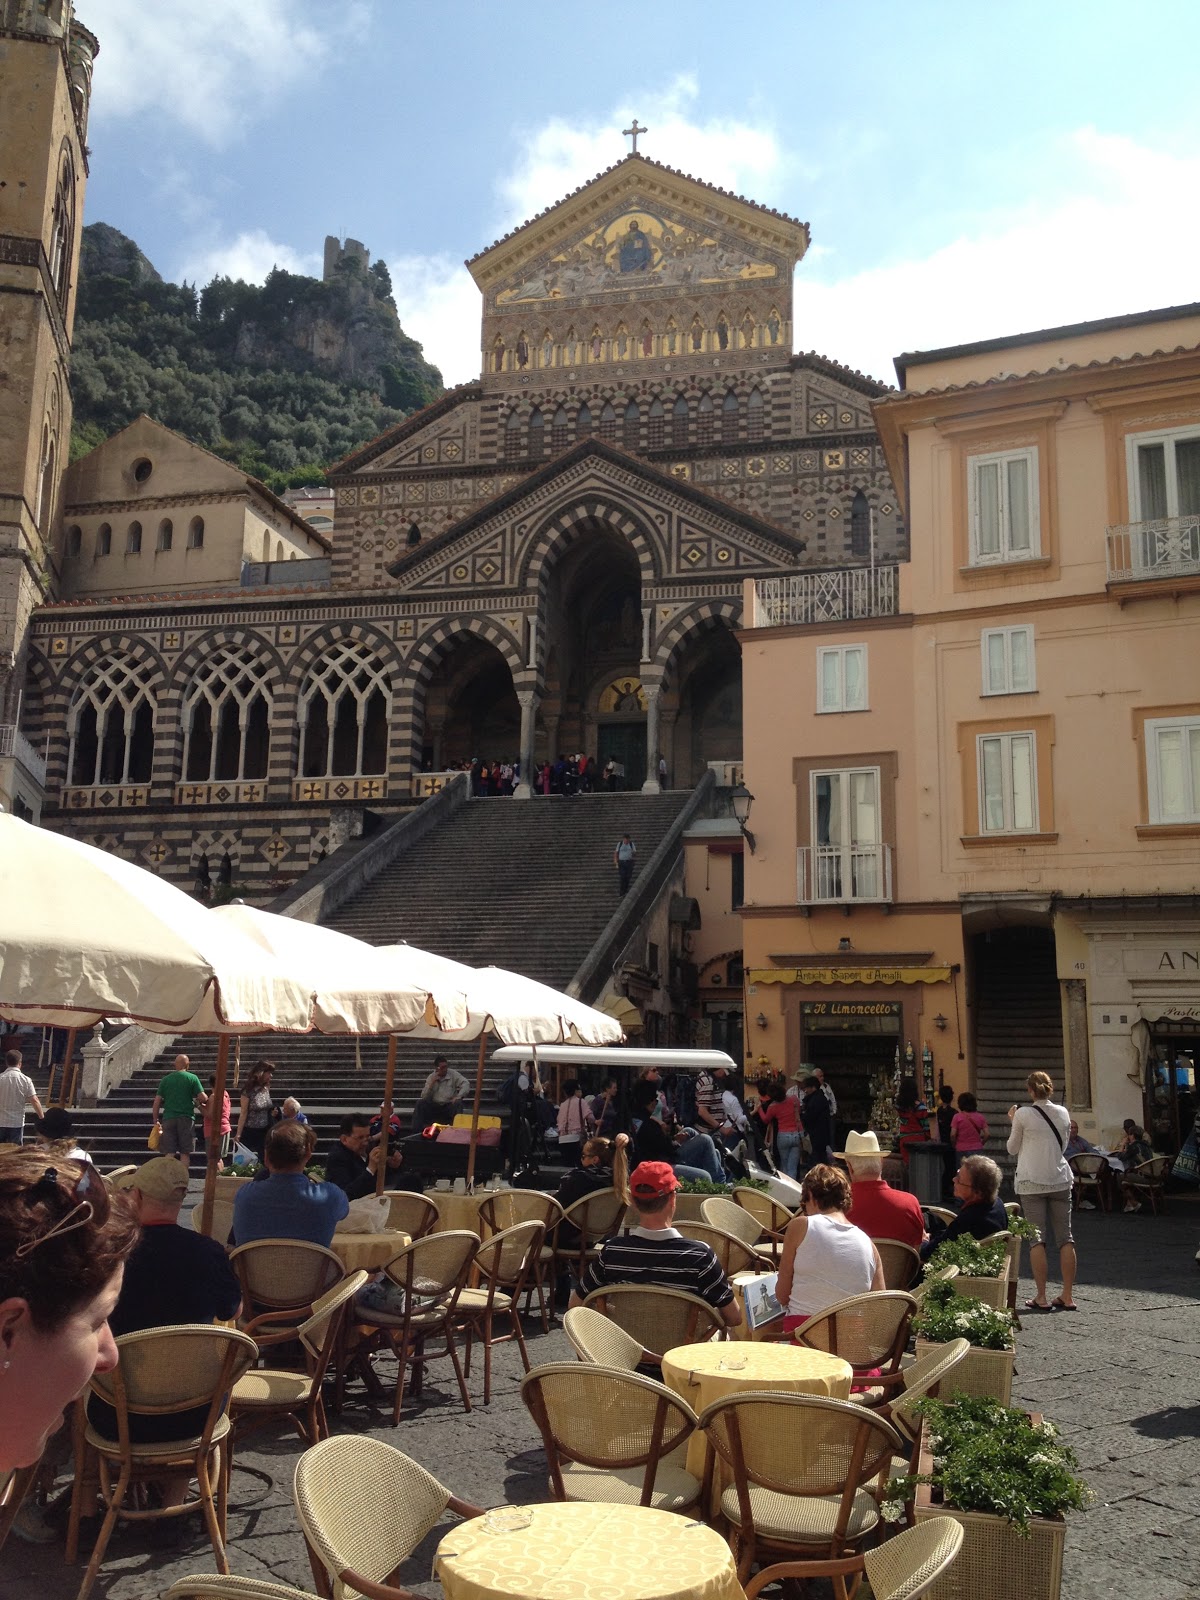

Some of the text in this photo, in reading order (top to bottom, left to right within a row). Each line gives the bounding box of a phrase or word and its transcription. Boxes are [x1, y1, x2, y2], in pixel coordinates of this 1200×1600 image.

[1074, 962, 1085, 970] 40
[795, 968, 827, 981] Antichi
[831, 968, 862, 981] Sapori
[814, 1003, 891, 1014] Il Limoncello
